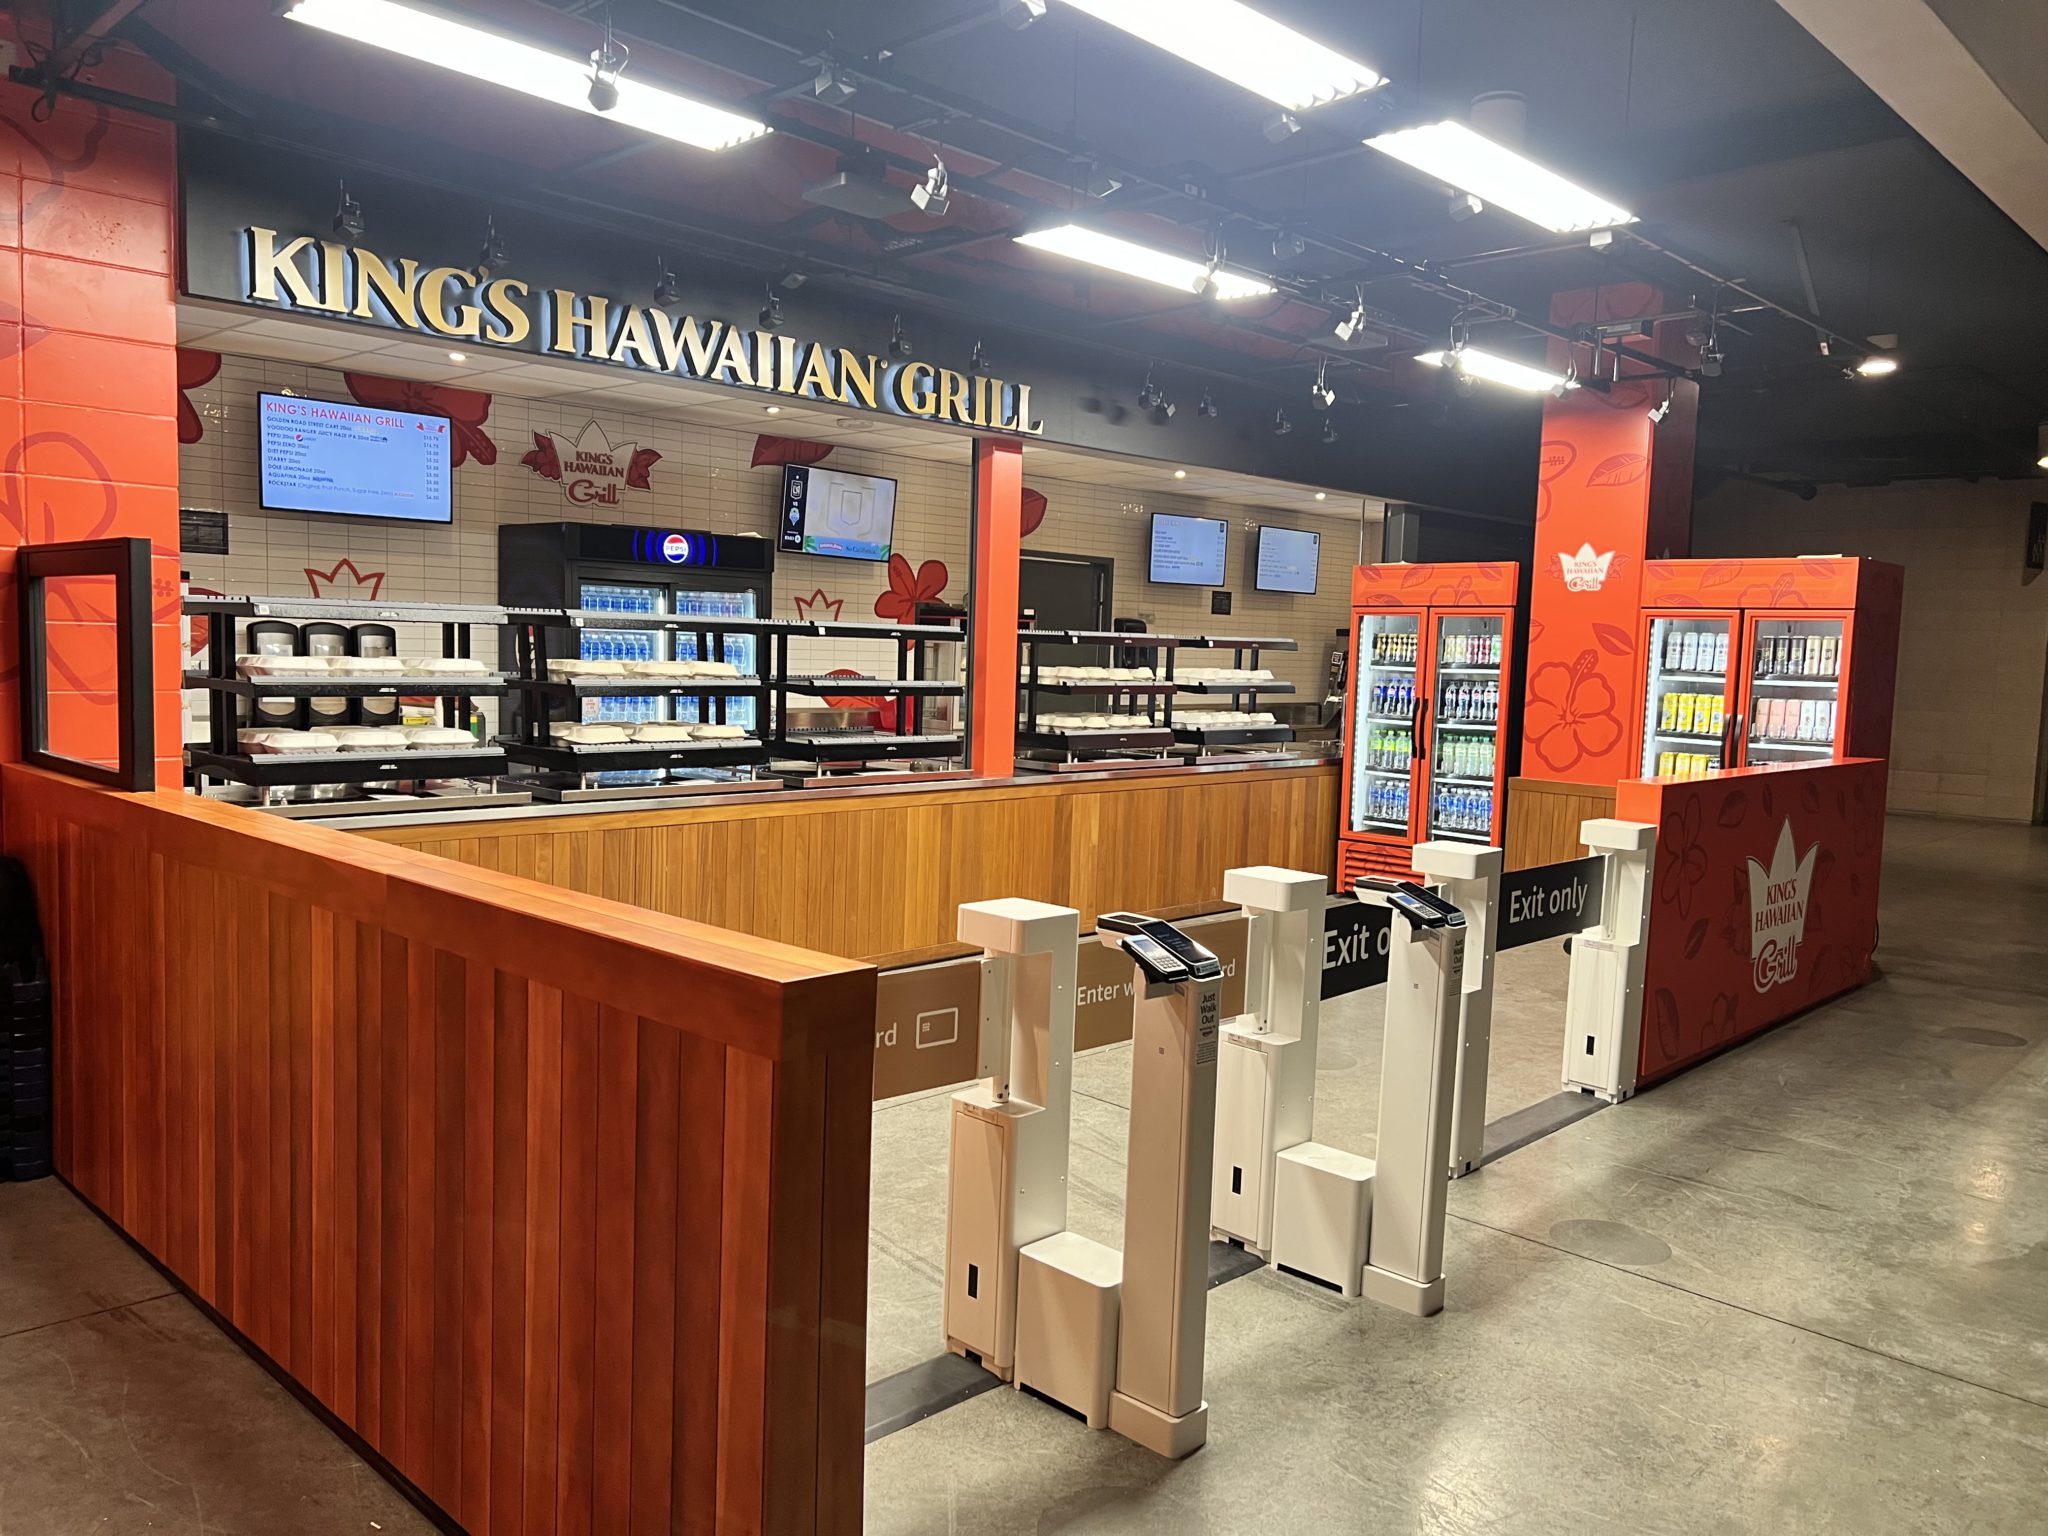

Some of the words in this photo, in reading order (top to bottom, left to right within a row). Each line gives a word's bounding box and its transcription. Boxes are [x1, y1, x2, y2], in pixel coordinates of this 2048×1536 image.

[250, 226, 531, 343] KING'S
[899, 361, 1044, 435] GRILL
[266, 401, 307, 416] KING'S
[311, 407, 371, 424] HAWAIIAN
[375, 416, 404, 428] GRILL
[267, 424, 294, 432] VOODOO
[563, 460, 625, 478] HAWAIIAN
[575, 451, 614, 465] KING'S
[568, 479, 620, 505] Grill
[665, 545, 687, 553] PEPSI
[1566, 567, 1604, 575] HAWAIIAN
[1509, 885, 1545, 924] Exit
[1549, 876, 1588, 917] only
[1766, 877, 1798, 906] KING'S
[1754, 899, 1804, 933] HAWAIIAN
[1322, 922, 1370, 970] Exit
[1755, 934, 1797, 989] Grill
[1076, 983, 1122, 1007] Enter
[1202, 992, 1216, 1003] Just
[1200, 1003, 1216, 1014] Walk
[1201, 1014, 1215, 1025] Out
